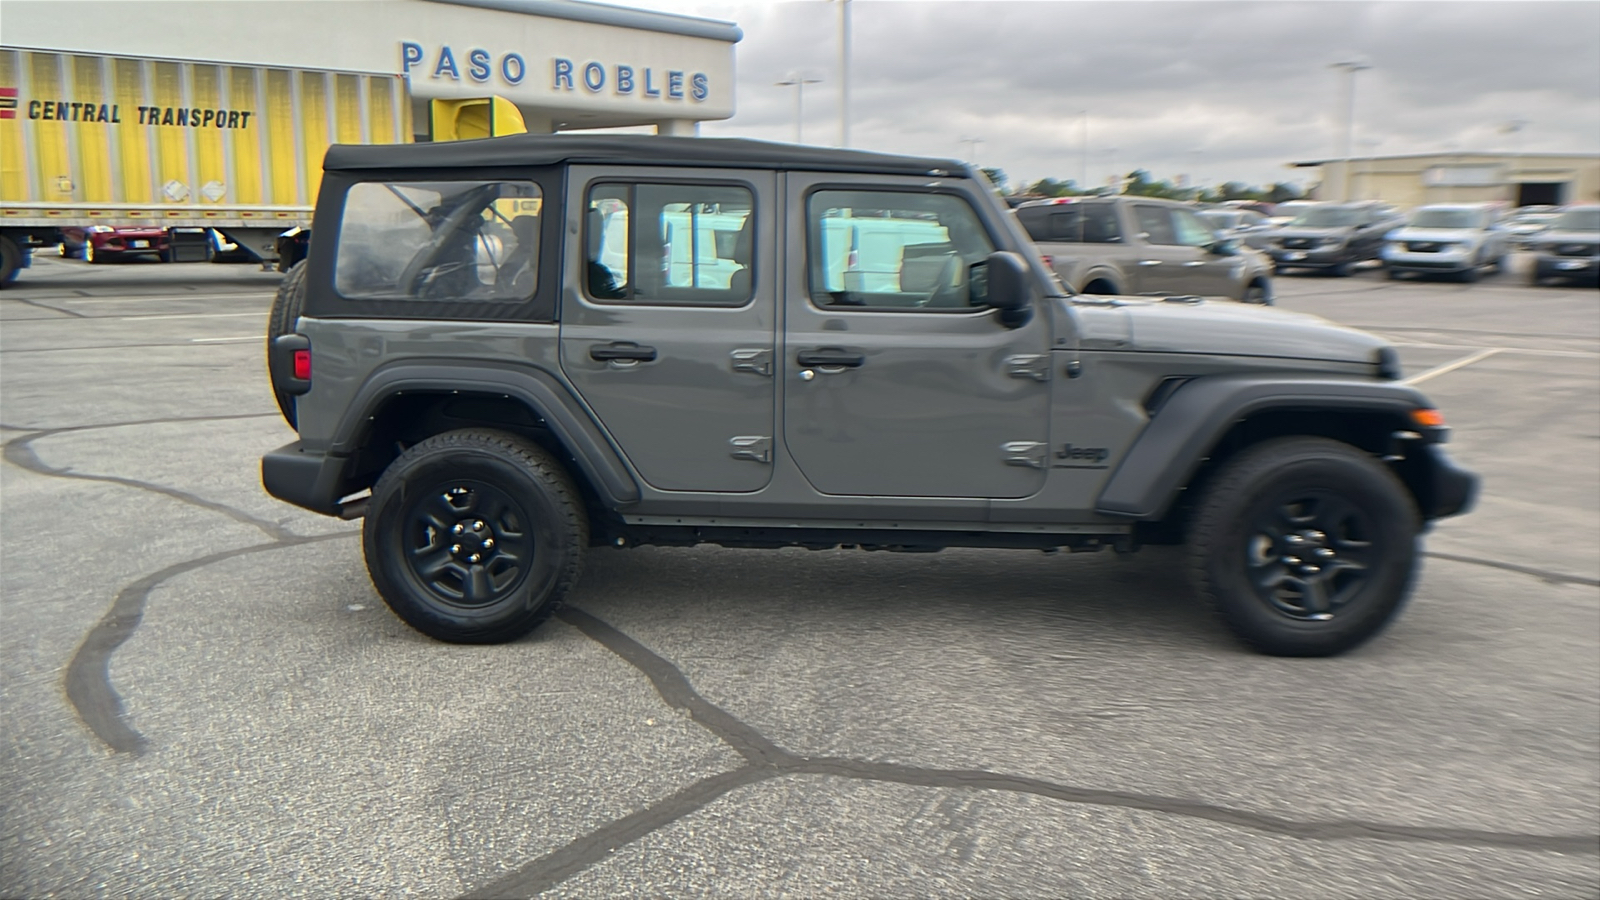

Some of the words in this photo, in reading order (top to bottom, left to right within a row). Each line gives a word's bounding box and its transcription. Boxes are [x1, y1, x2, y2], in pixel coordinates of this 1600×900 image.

[401, 41, 527, 85] PASO
[553, 57, 710, 100] ROBLES
[28, 100, 121, 124] CENTRAL
[138, 106, 251, 129] TRANSPORT
[1054, 443, 1109, 463] Jeep
